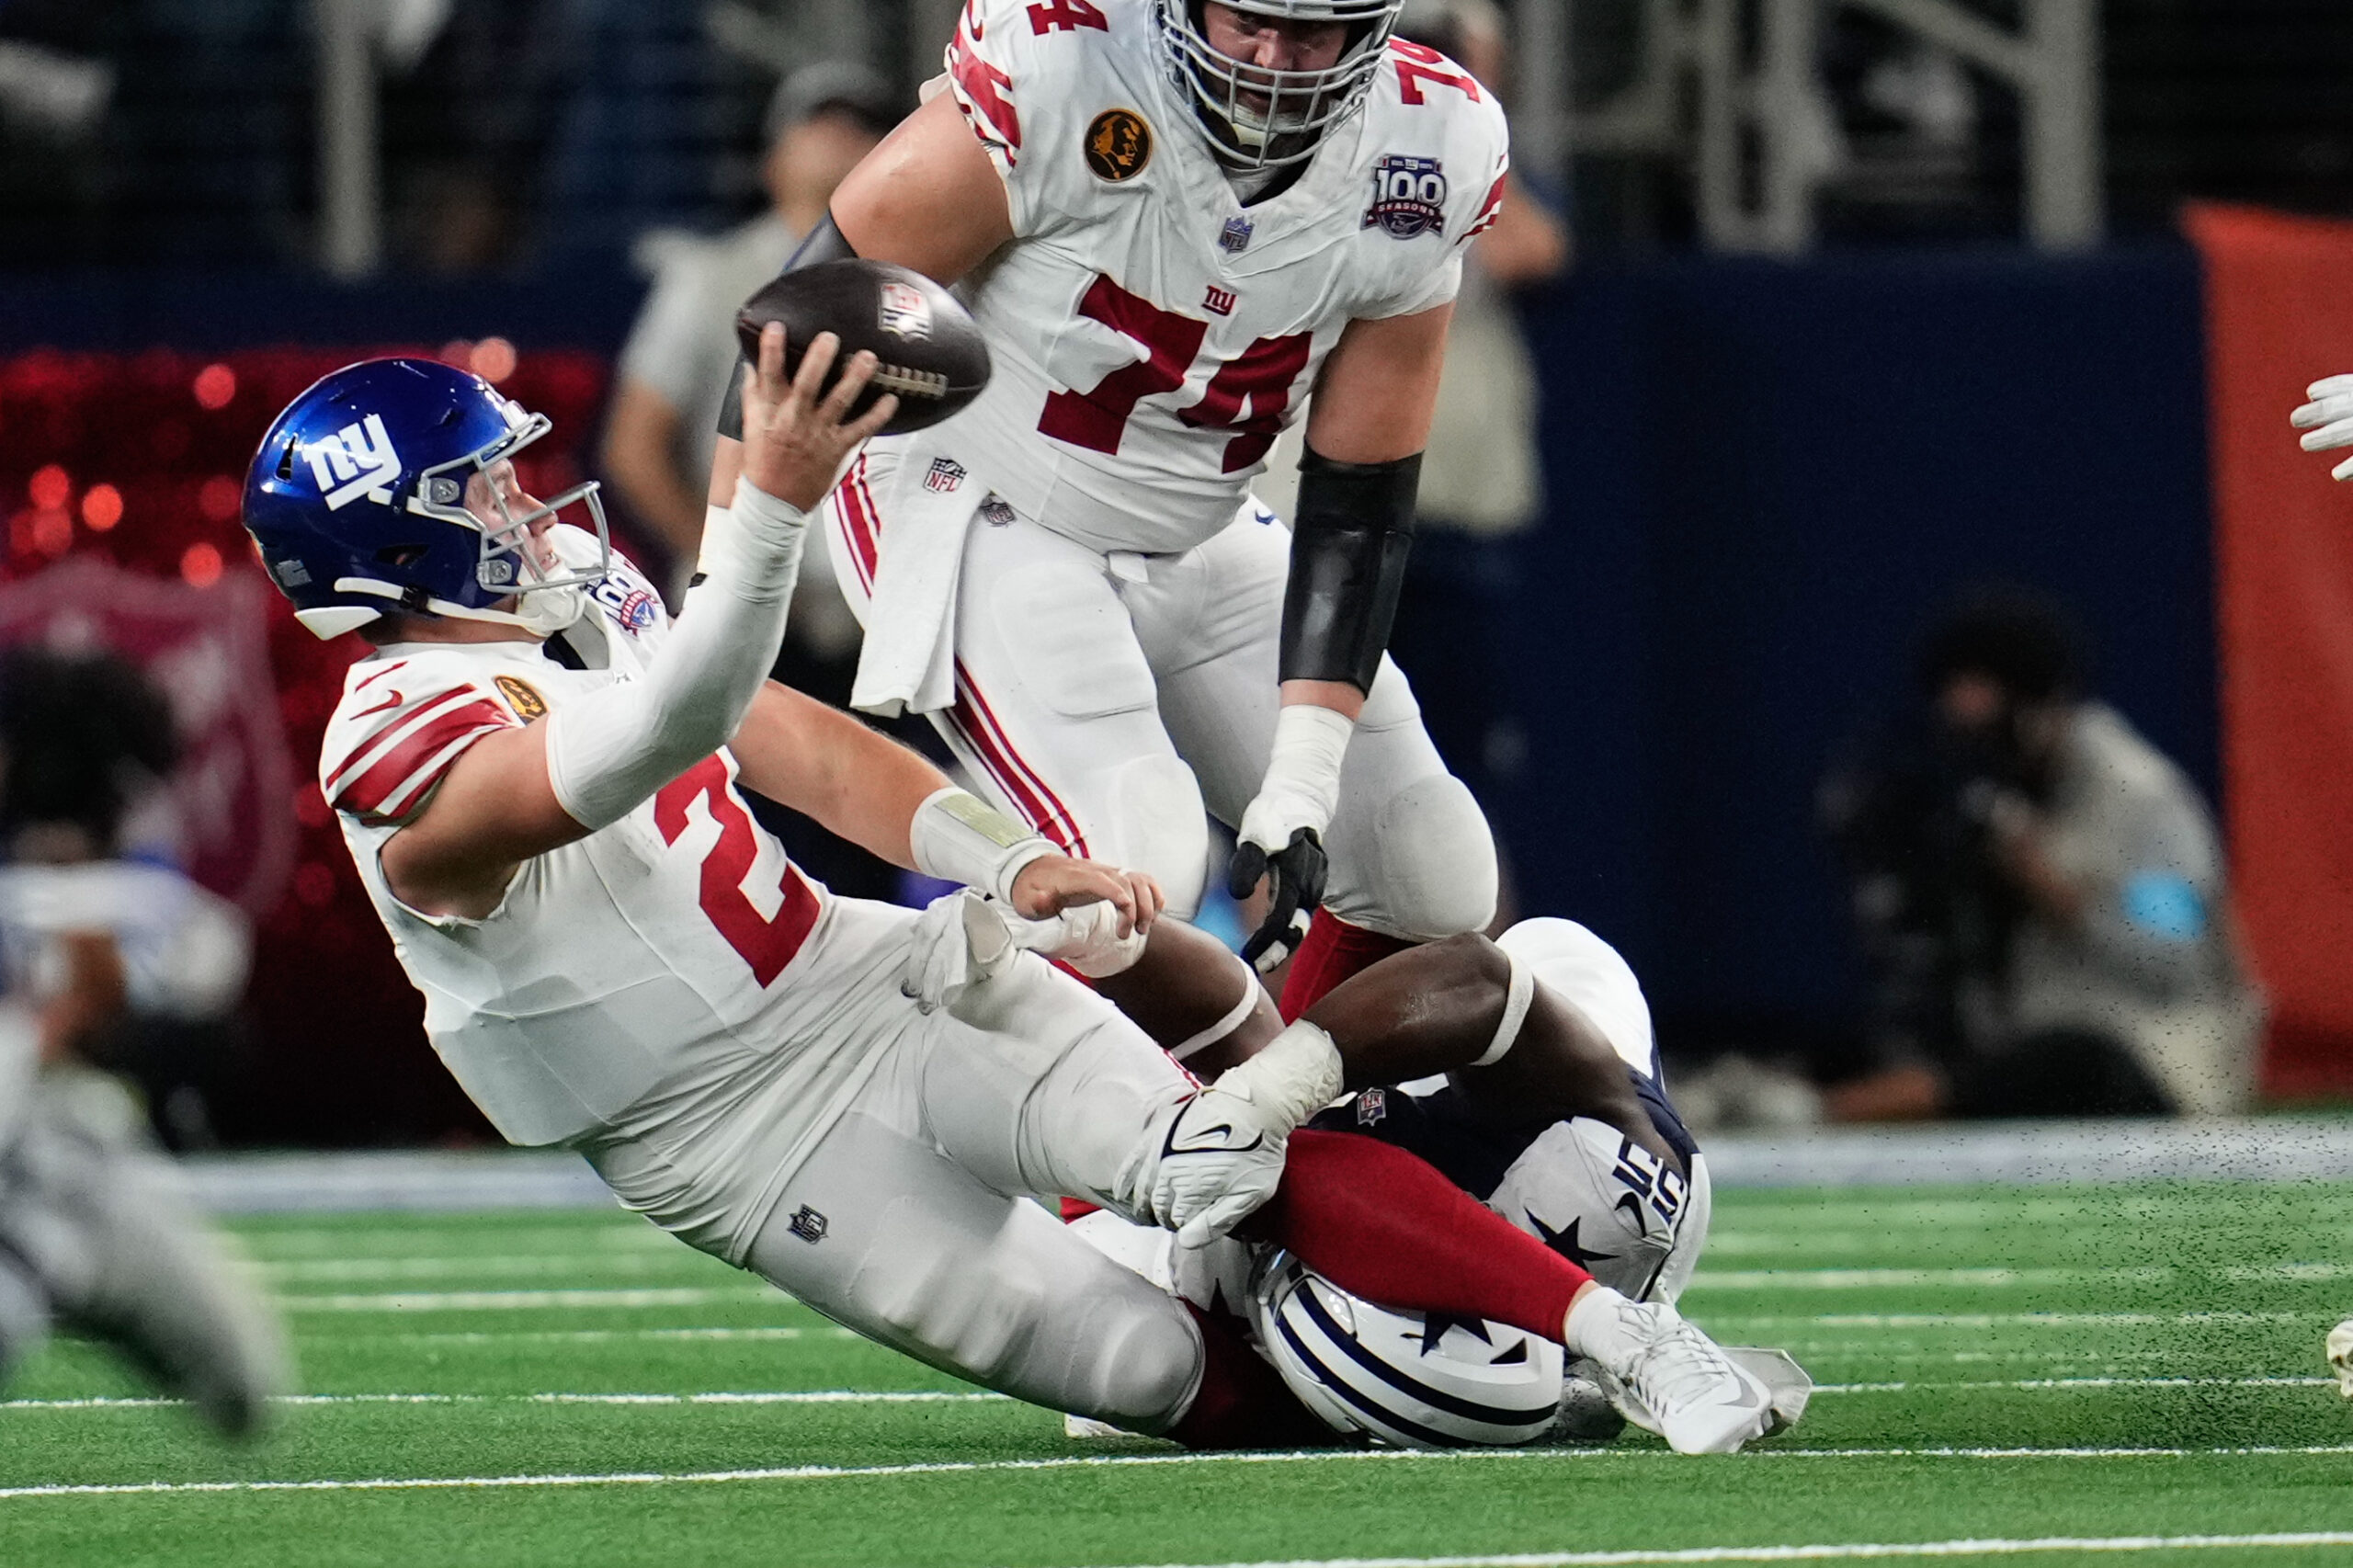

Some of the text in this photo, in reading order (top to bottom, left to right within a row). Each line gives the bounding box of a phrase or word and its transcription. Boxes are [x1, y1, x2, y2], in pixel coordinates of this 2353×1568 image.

[1386, 39, 1481, 105] 74
[1376, 168, 1445, 208] 100
[1378, 202, 1435, 216] SEASONS
[1037, 272, 1313, 474] 74
[926, 471, 958, 492] NFL
[654, 753, 821, 990] 2
[1361, 1094, 1381, 1111] NFL
